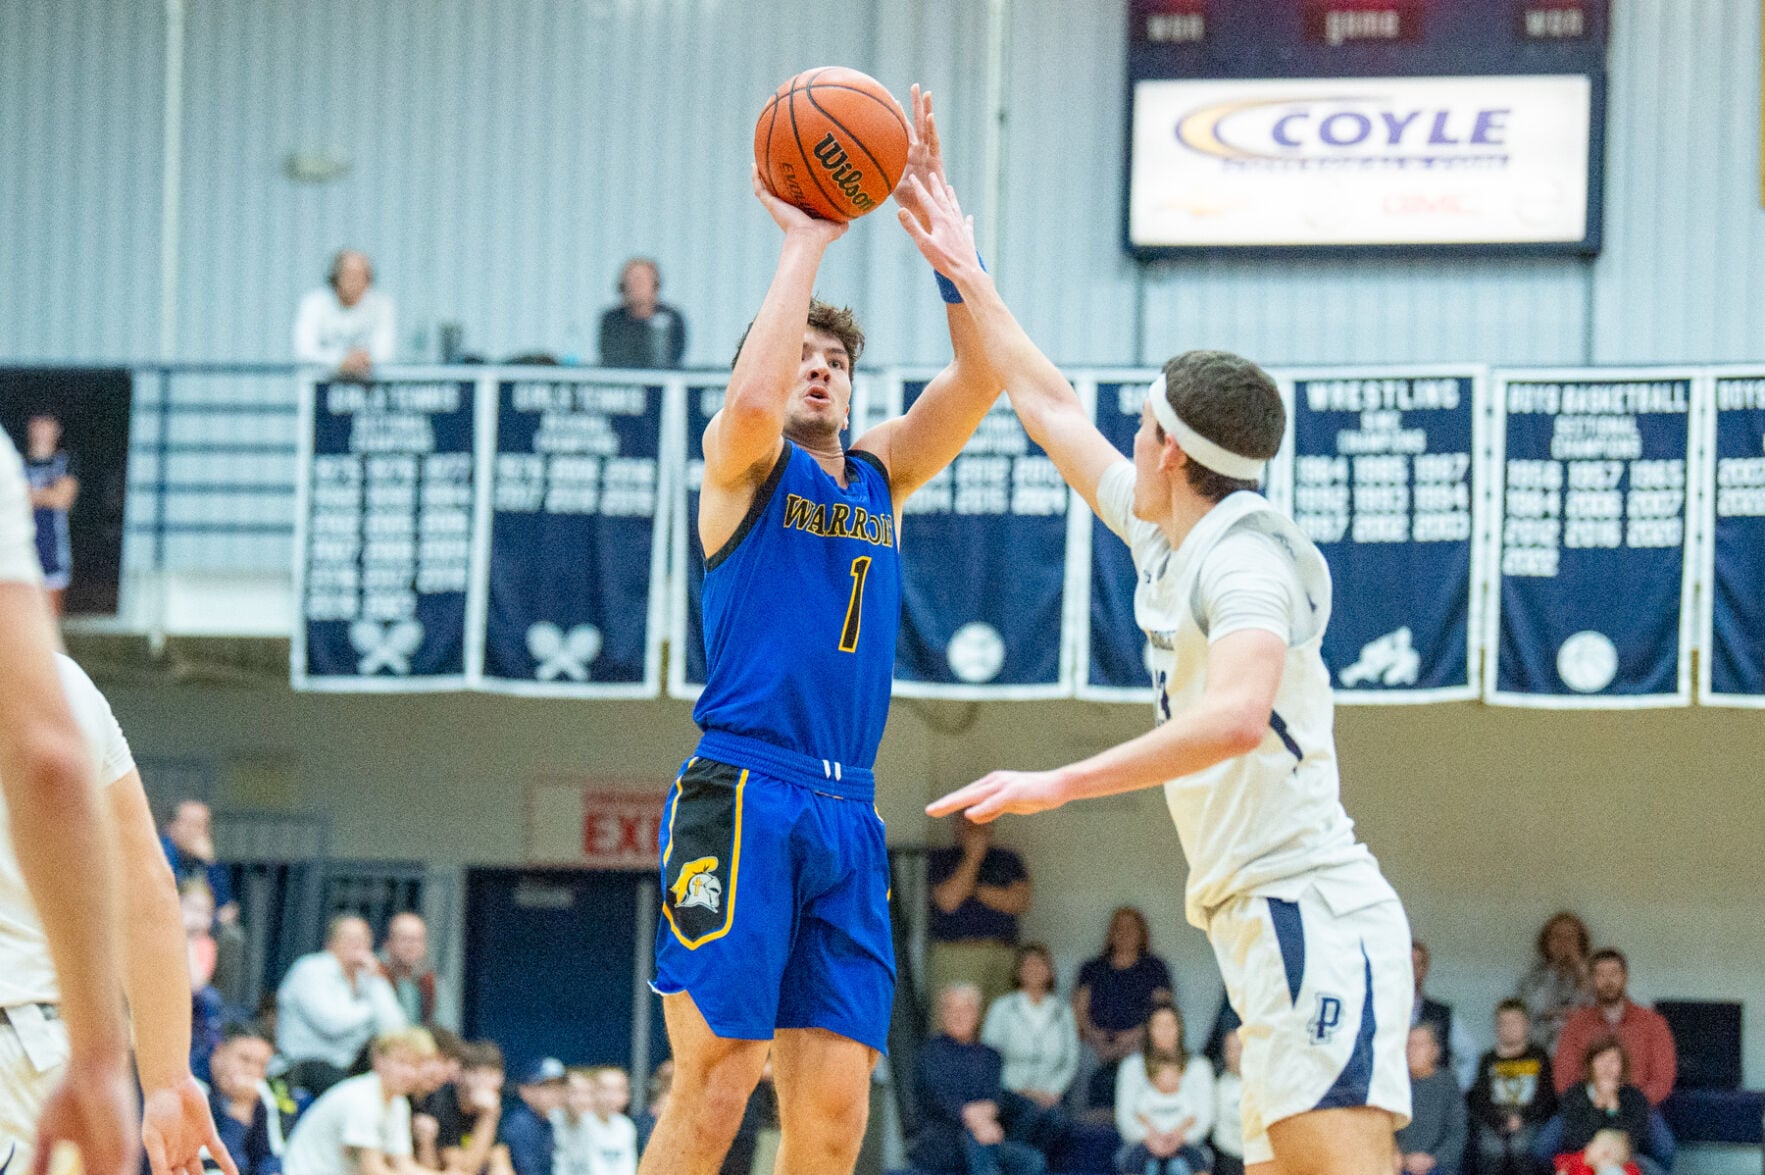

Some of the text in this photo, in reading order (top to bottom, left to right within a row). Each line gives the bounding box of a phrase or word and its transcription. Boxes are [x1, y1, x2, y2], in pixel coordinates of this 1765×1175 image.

[1272, 107, 1511, 147] COYLE
[814, 132, 875, 211] Wilson
[1306, 380, 1460, 411] WRESTLING
[1562, 383, 1688, 414] BASKETBALL
[839, 555, 872, 653] 1
[584, 815, 661, 854] EXI
[1310, 993, 1344, 1043] P
